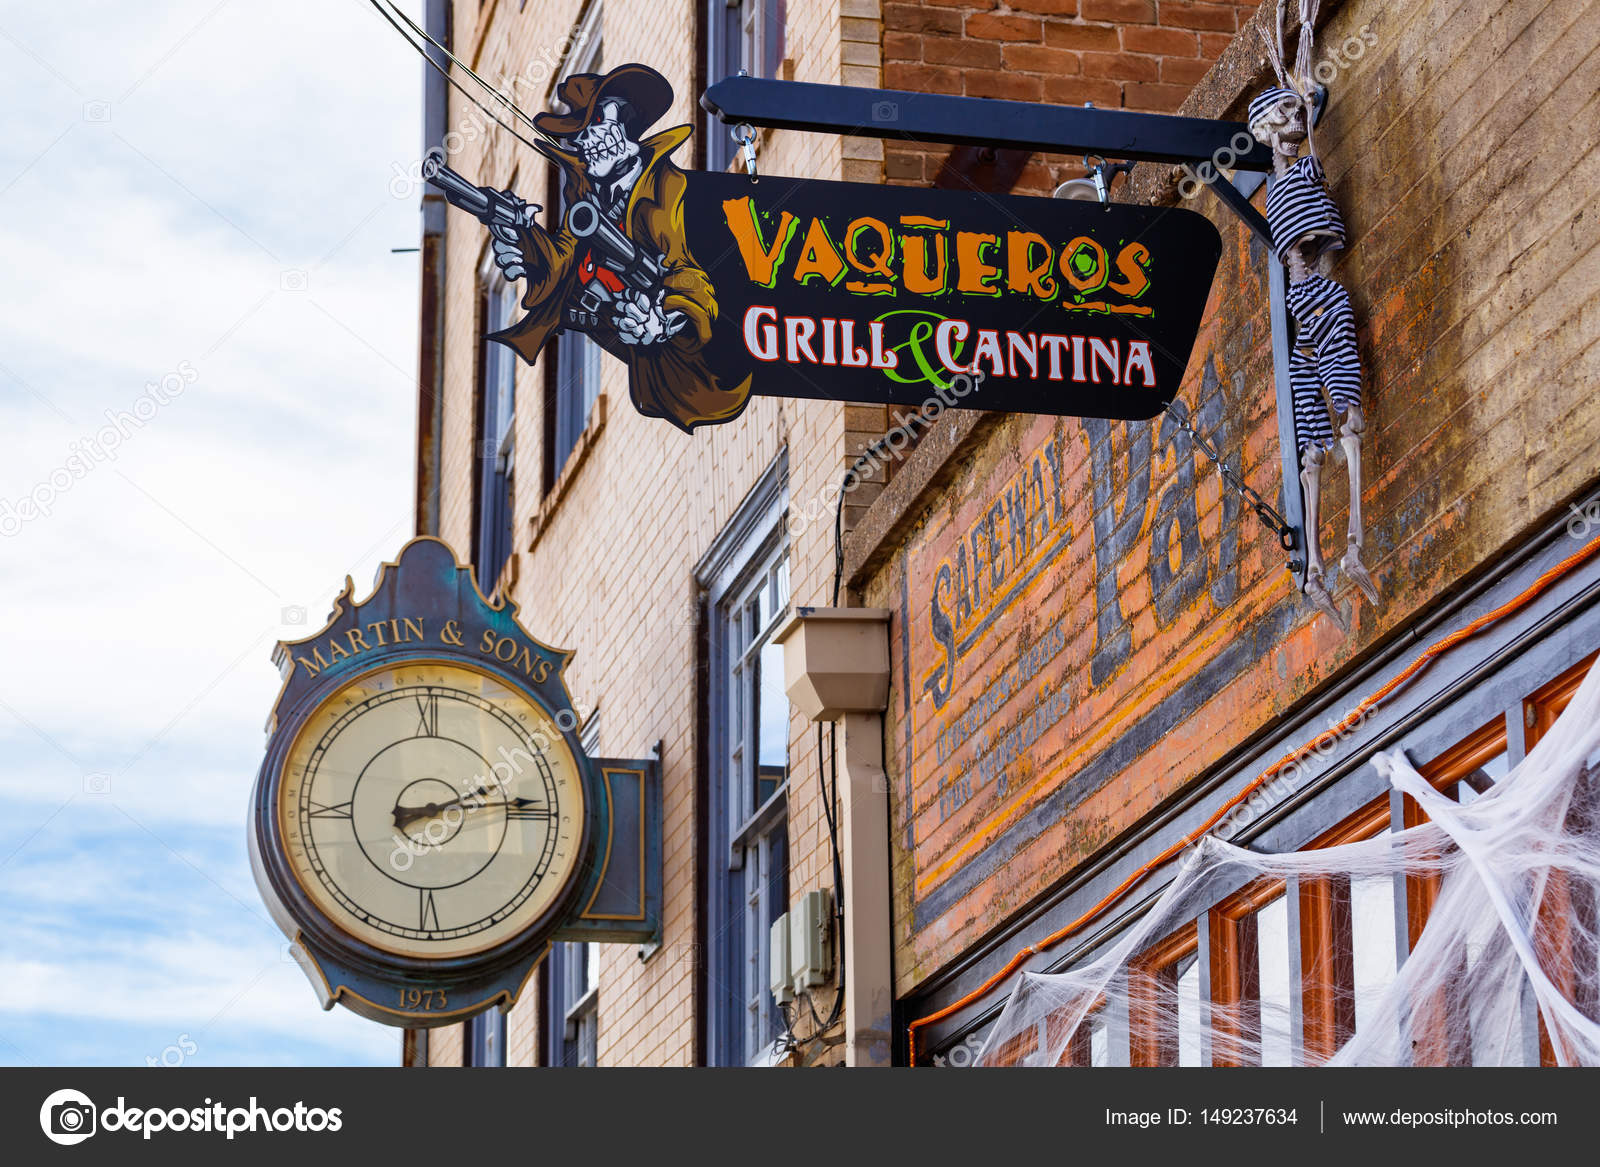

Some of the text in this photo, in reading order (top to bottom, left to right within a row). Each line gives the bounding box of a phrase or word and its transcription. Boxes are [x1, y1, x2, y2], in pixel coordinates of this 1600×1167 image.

[722, 196, 1156, 317] VAQUEROS
[744, 305, 1157, 390] GRILL & CANTINA
[922, 436, 1067, 710] SAFEWAY
[296, 617, 554, 684] MARTIN & SONS
[398, 989, 448, 1011] 1973
